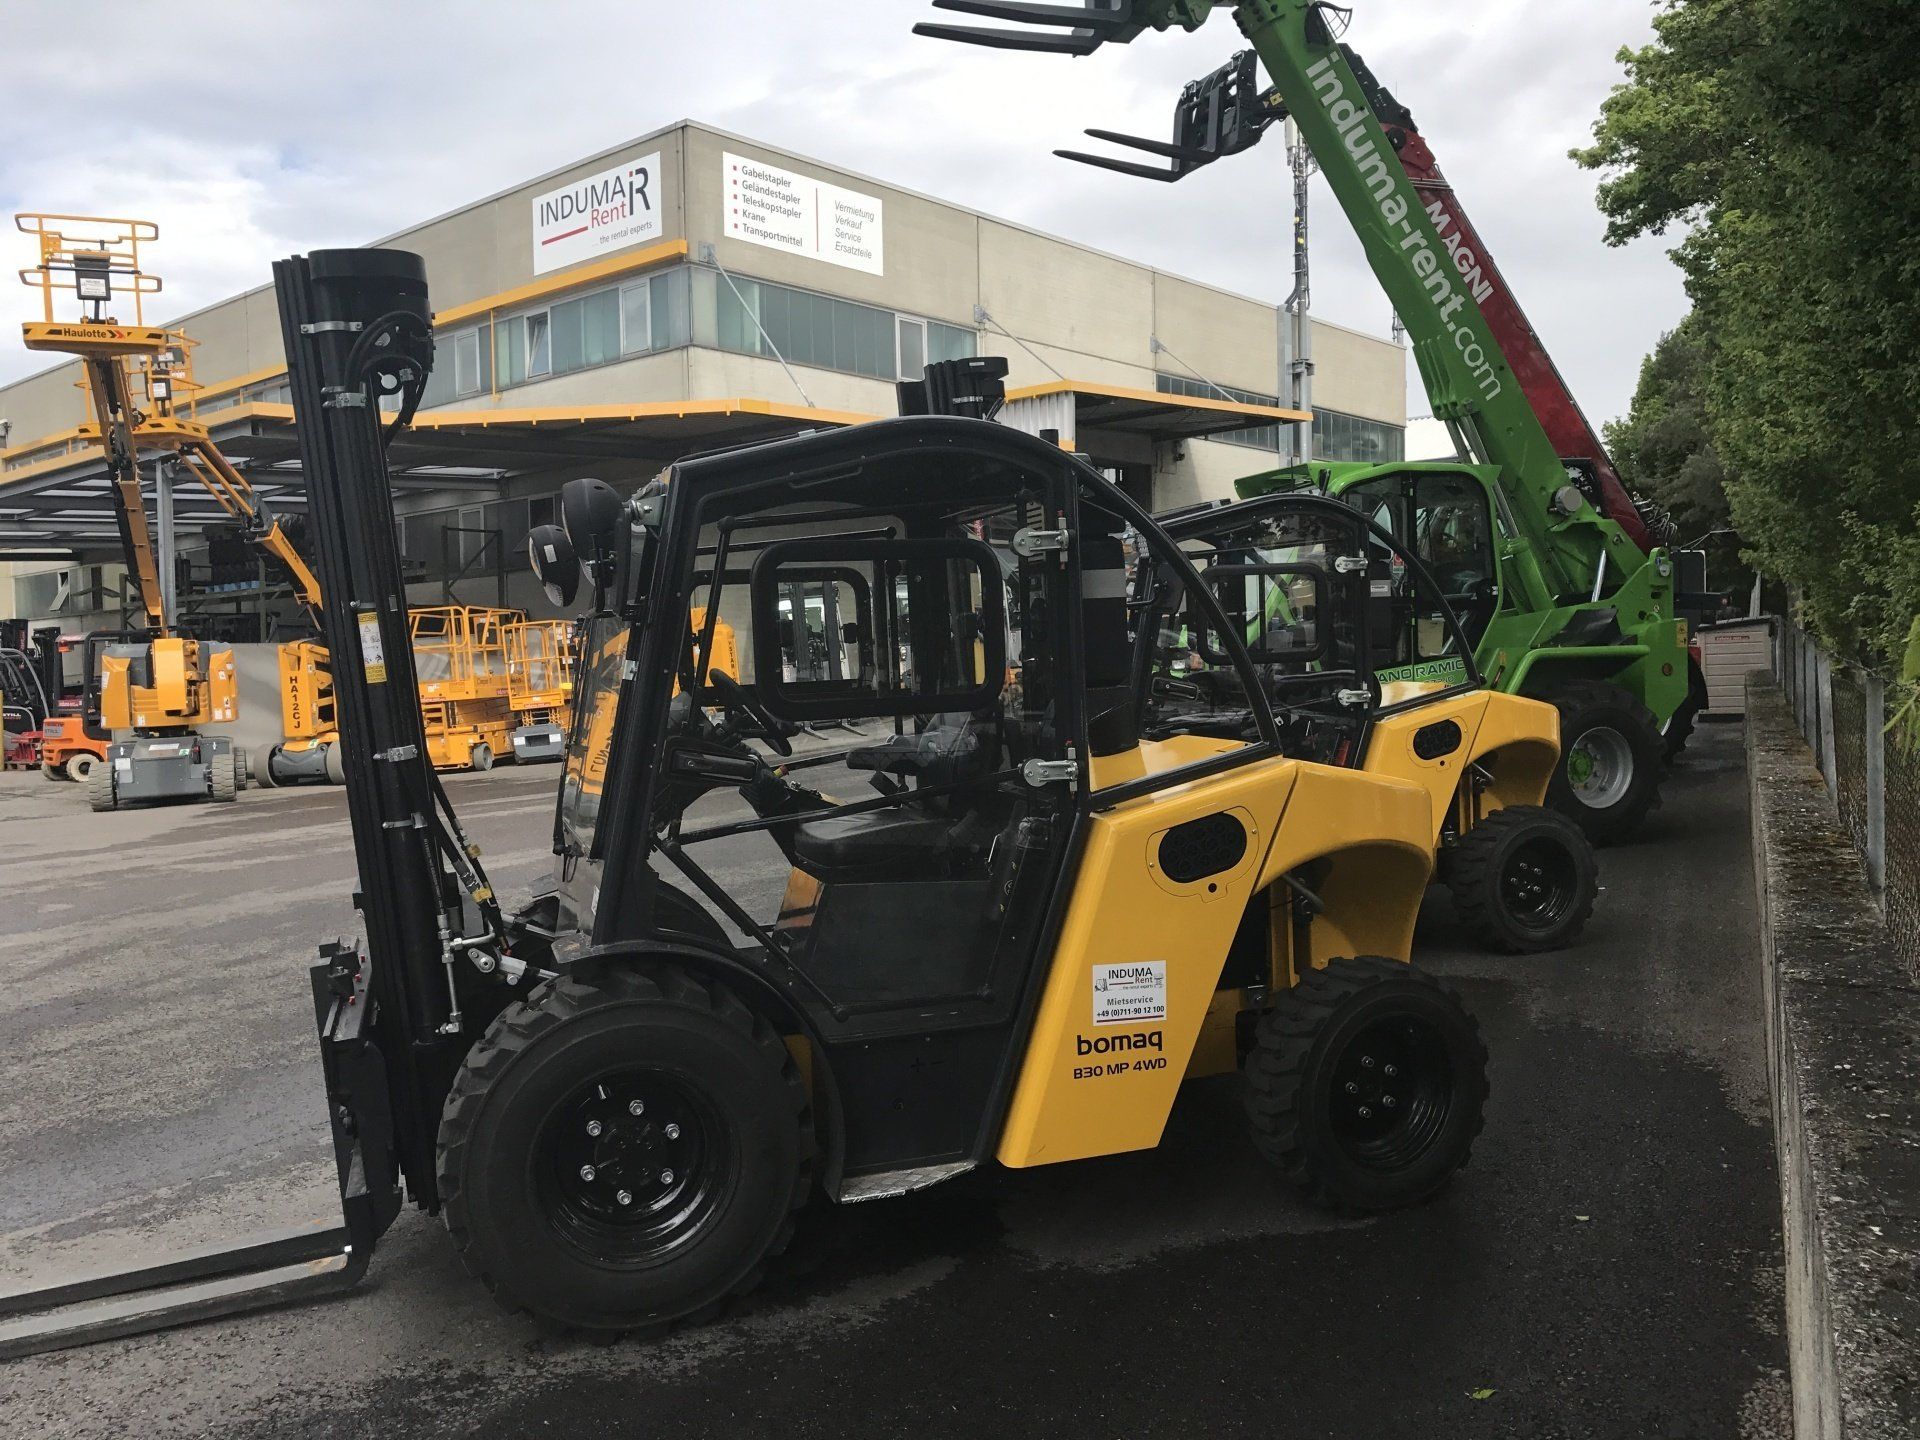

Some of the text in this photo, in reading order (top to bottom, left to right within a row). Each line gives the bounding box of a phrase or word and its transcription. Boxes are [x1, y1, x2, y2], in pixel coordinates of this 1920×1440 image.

[741, 165, 792, 188] Gabelstapler
[741, 180, 801, 205] Geländestapler
[591, 200, 627, 229] Rent
[741, 194, 802, 219] Teleskopstapler
[834, 200, 875, 223] Vermietung
[599, 220, 653, 244] the rental experts
[834, 214, 863, 231] Verkauf
[1305, 51, 1502, 401] induma-rent.com
[742, 223, 803, 247] Transportmittel
[834, 227, 862, 243] Service
[834, 241, 872, 260] Ersatzteile
[1425, 200, 1494, 305] MAGNI
[63, 327, 107, 339] Haulotte
[1379, 660, 1465, 682] ANORAMIC
[289, 676, 301, 729] HA12CJ
[1108, 967, 1153, 979] INDUMA
[1135, 976, 1153, 984] Rent
[1097, 1005, 1165, 1017] +49 (0)711-90 12 100
[1106, 995, 1154, 1006] Mietservice
[1076, 1031, 1163, 1056] bomaq
[1073, 1057, 1167, 1080] B30 MP 4WD
